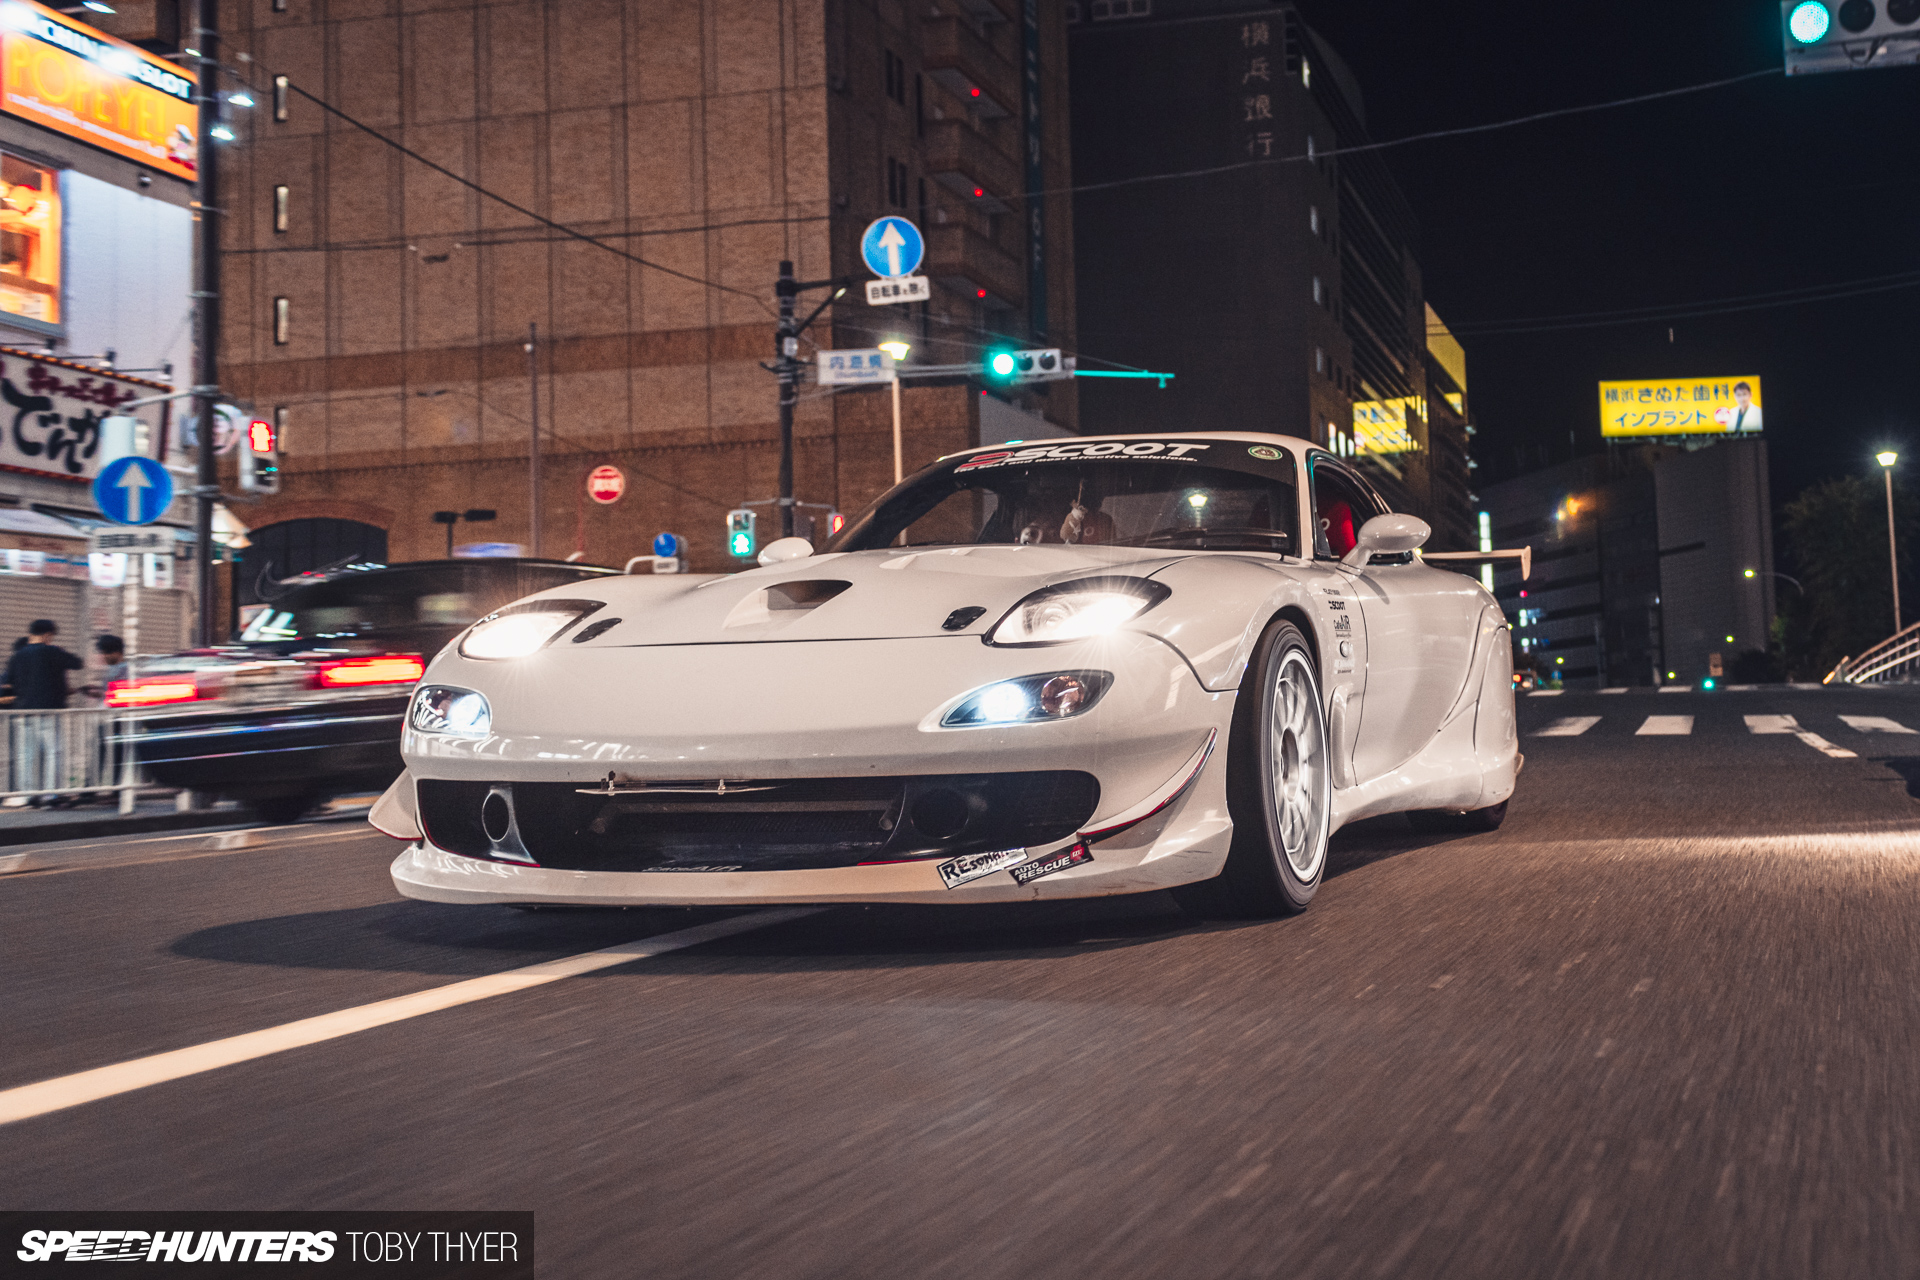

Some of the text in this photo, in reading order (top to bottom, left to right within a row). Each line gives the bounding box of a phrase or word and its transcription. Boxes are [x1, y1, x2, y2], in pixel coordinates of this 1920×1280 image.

[139, 63, 193, 98] SLOT
[1605, 383, 1730, 404] 横浜きぬた歯科
[1614, 409, 1707, 427] インプラント
[1014, 861, 1039, 876] AUTO
[1018, 856, 1070, 881] RESCUE
